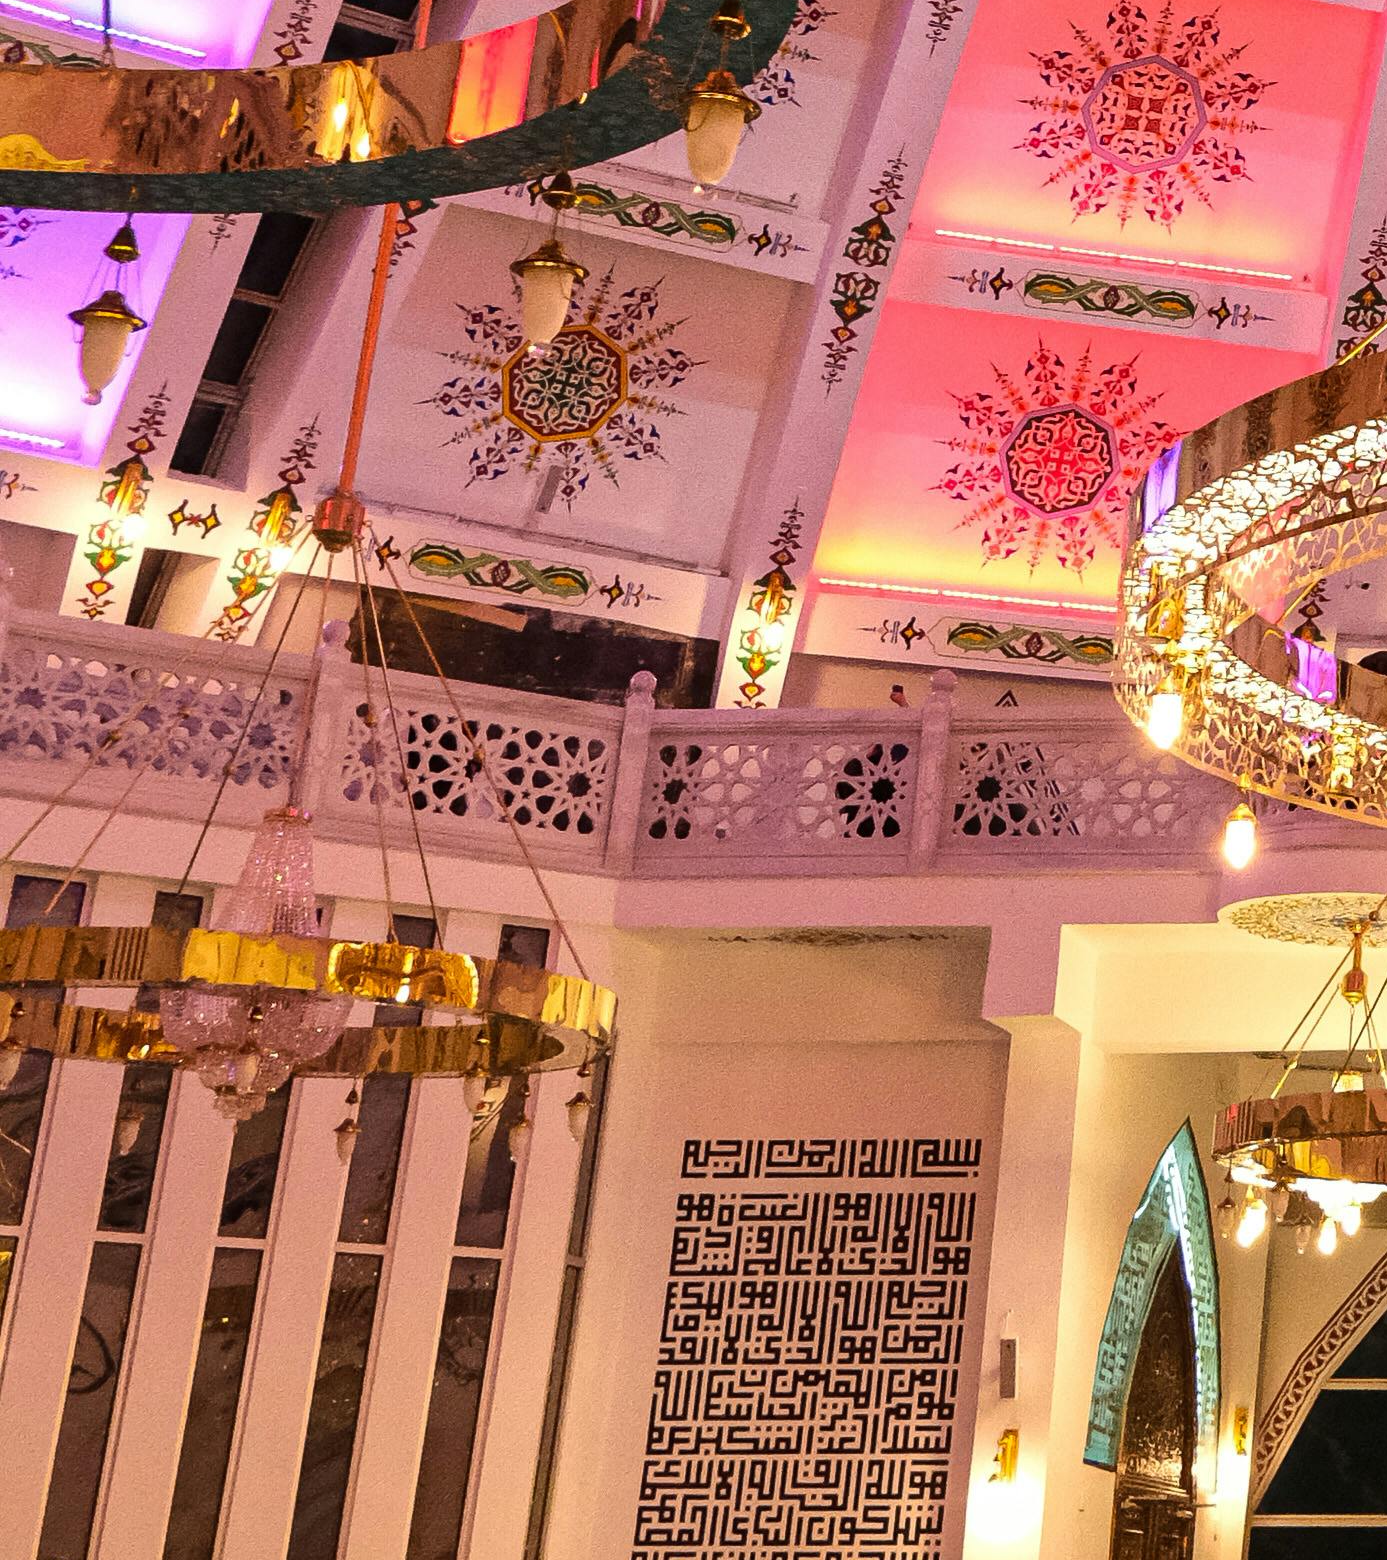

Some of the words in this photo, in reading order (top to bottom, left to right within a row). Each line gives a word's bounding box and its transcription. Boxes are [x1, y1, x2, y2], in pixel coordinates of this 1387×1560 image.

[681, 1139, 764, 1179] الرحيم
[765, 1139, 857, 1179] الرحمن
[859, 1139, 909, 1179] الله
[911, 1139, 982, 1179] بسم
[676, 1193, 715, 1222] هو
[832, 1193, 872, 1222] هو
[932, 1247, 972, 1276] هو
[739, 1281, 778, 1309] هو
[884, 1281, 968, 1320] الرحيم
[839, 1336, 878, 1364] هو
[880, 1324, 964, 1364] الرحمن
